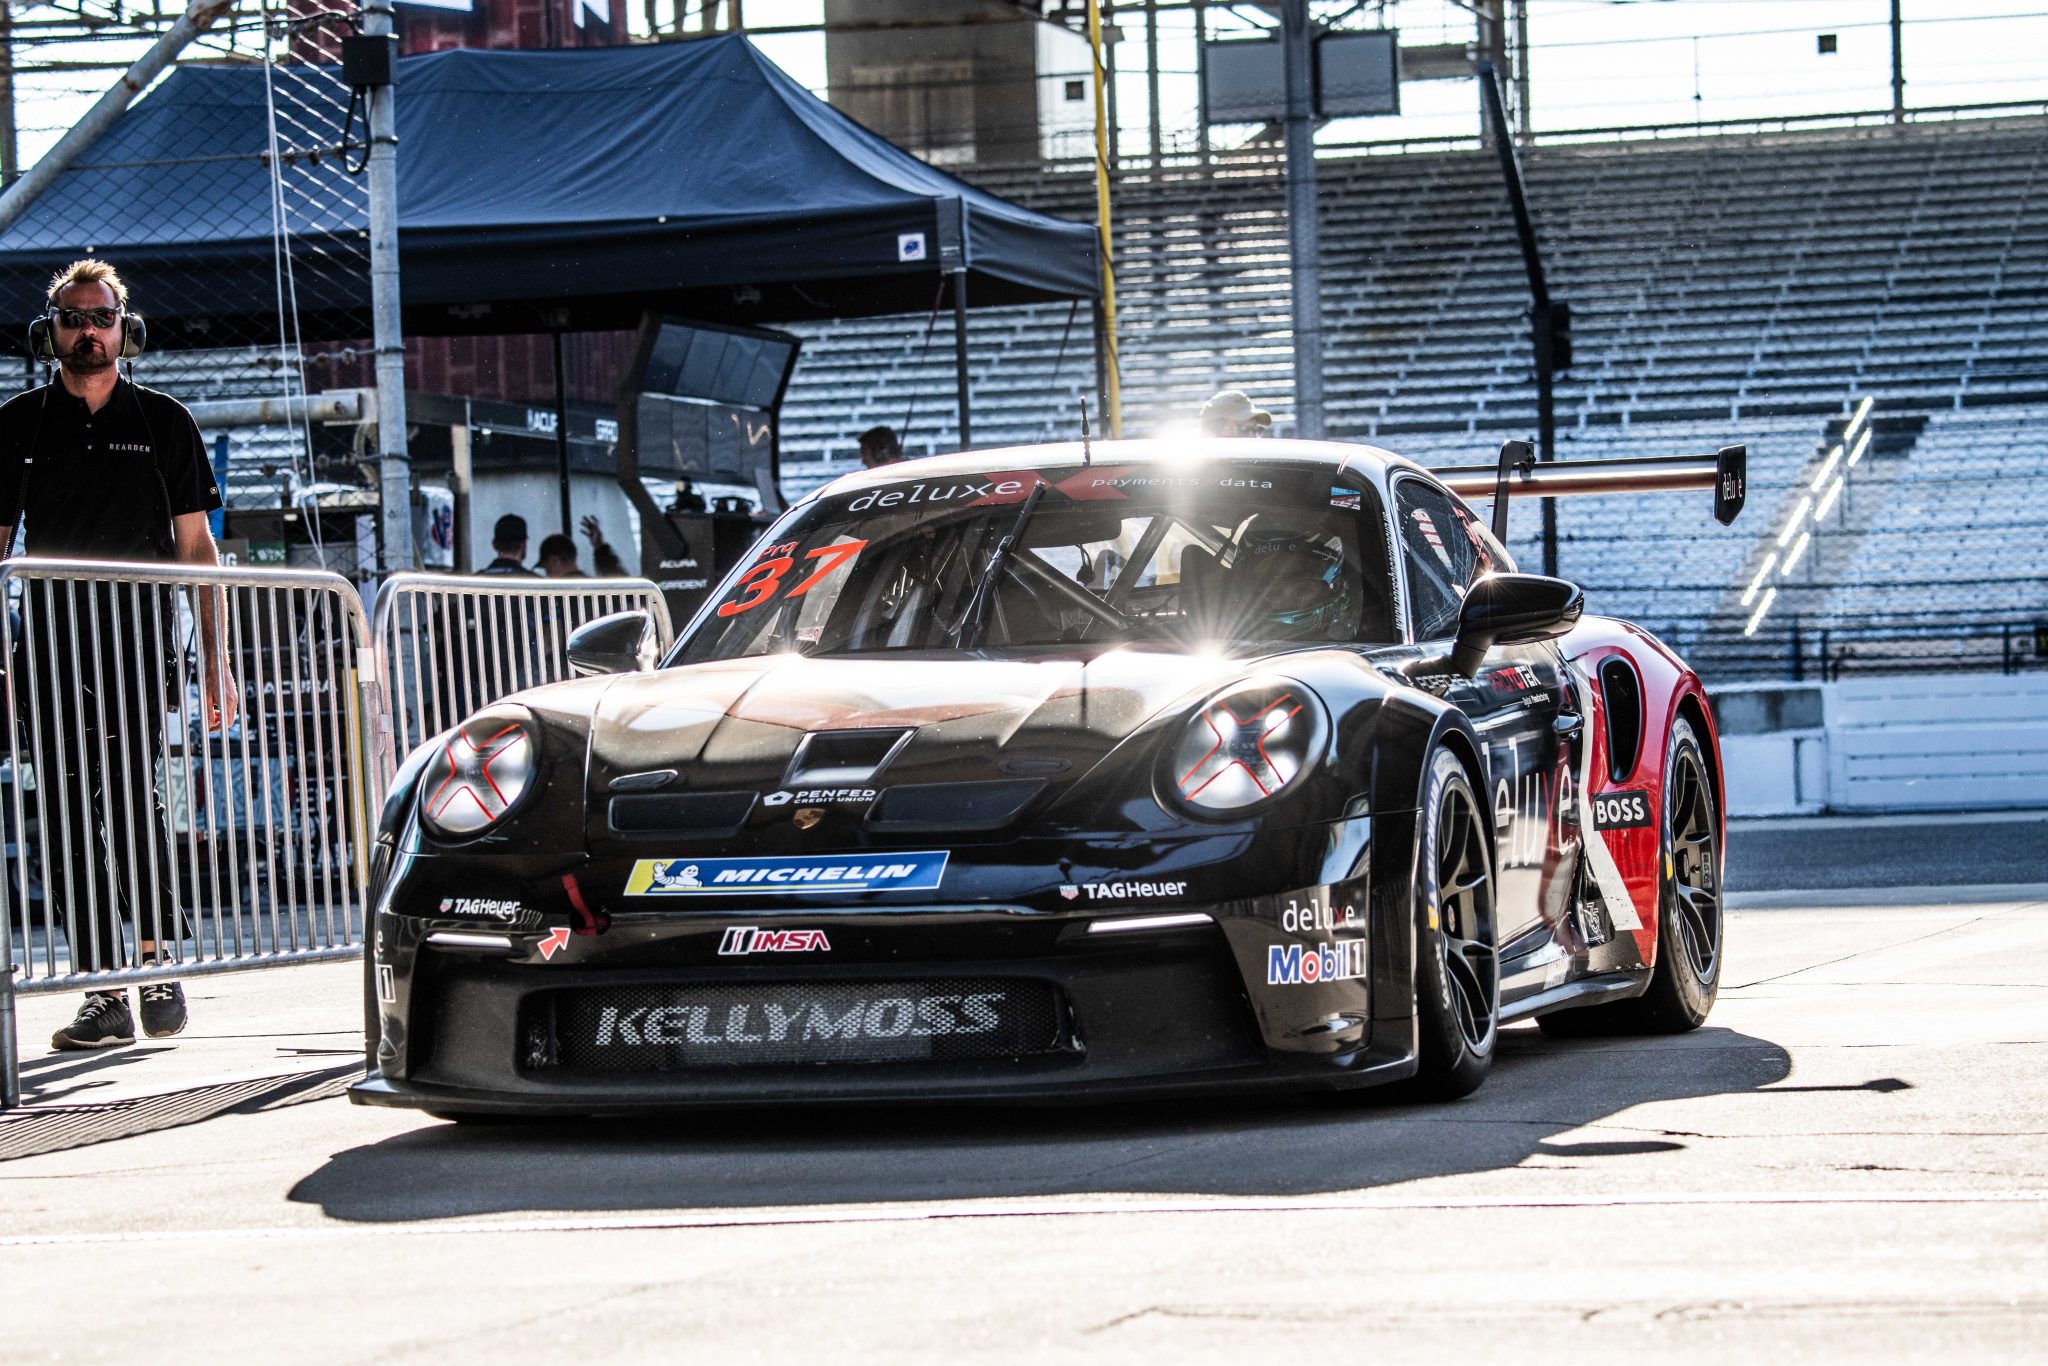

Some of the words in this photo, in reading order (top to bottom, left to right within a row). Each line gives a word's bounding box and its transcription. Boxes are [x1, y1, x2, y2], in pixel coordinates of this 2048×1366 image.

[109, 443, 151, 453] REARDEN
[1091, 478, 1200, 488] payments
[1219, 478, 1273, 489] data
[848, 480, 1022, 513] deluxe
[1254, 542, 1297, 556] delue
[717, 539, 869, 618] 37
[793, 797, 835, 805] CREDIT
[795, 789, 877, 799] PENFED
[1596, 797, 1645, 825] BOSS
[712, 864, 918, 883] MICHELIN
[1282, 898, 1356, 933] deluxe
[751, 929, 832, 953] IMSA
